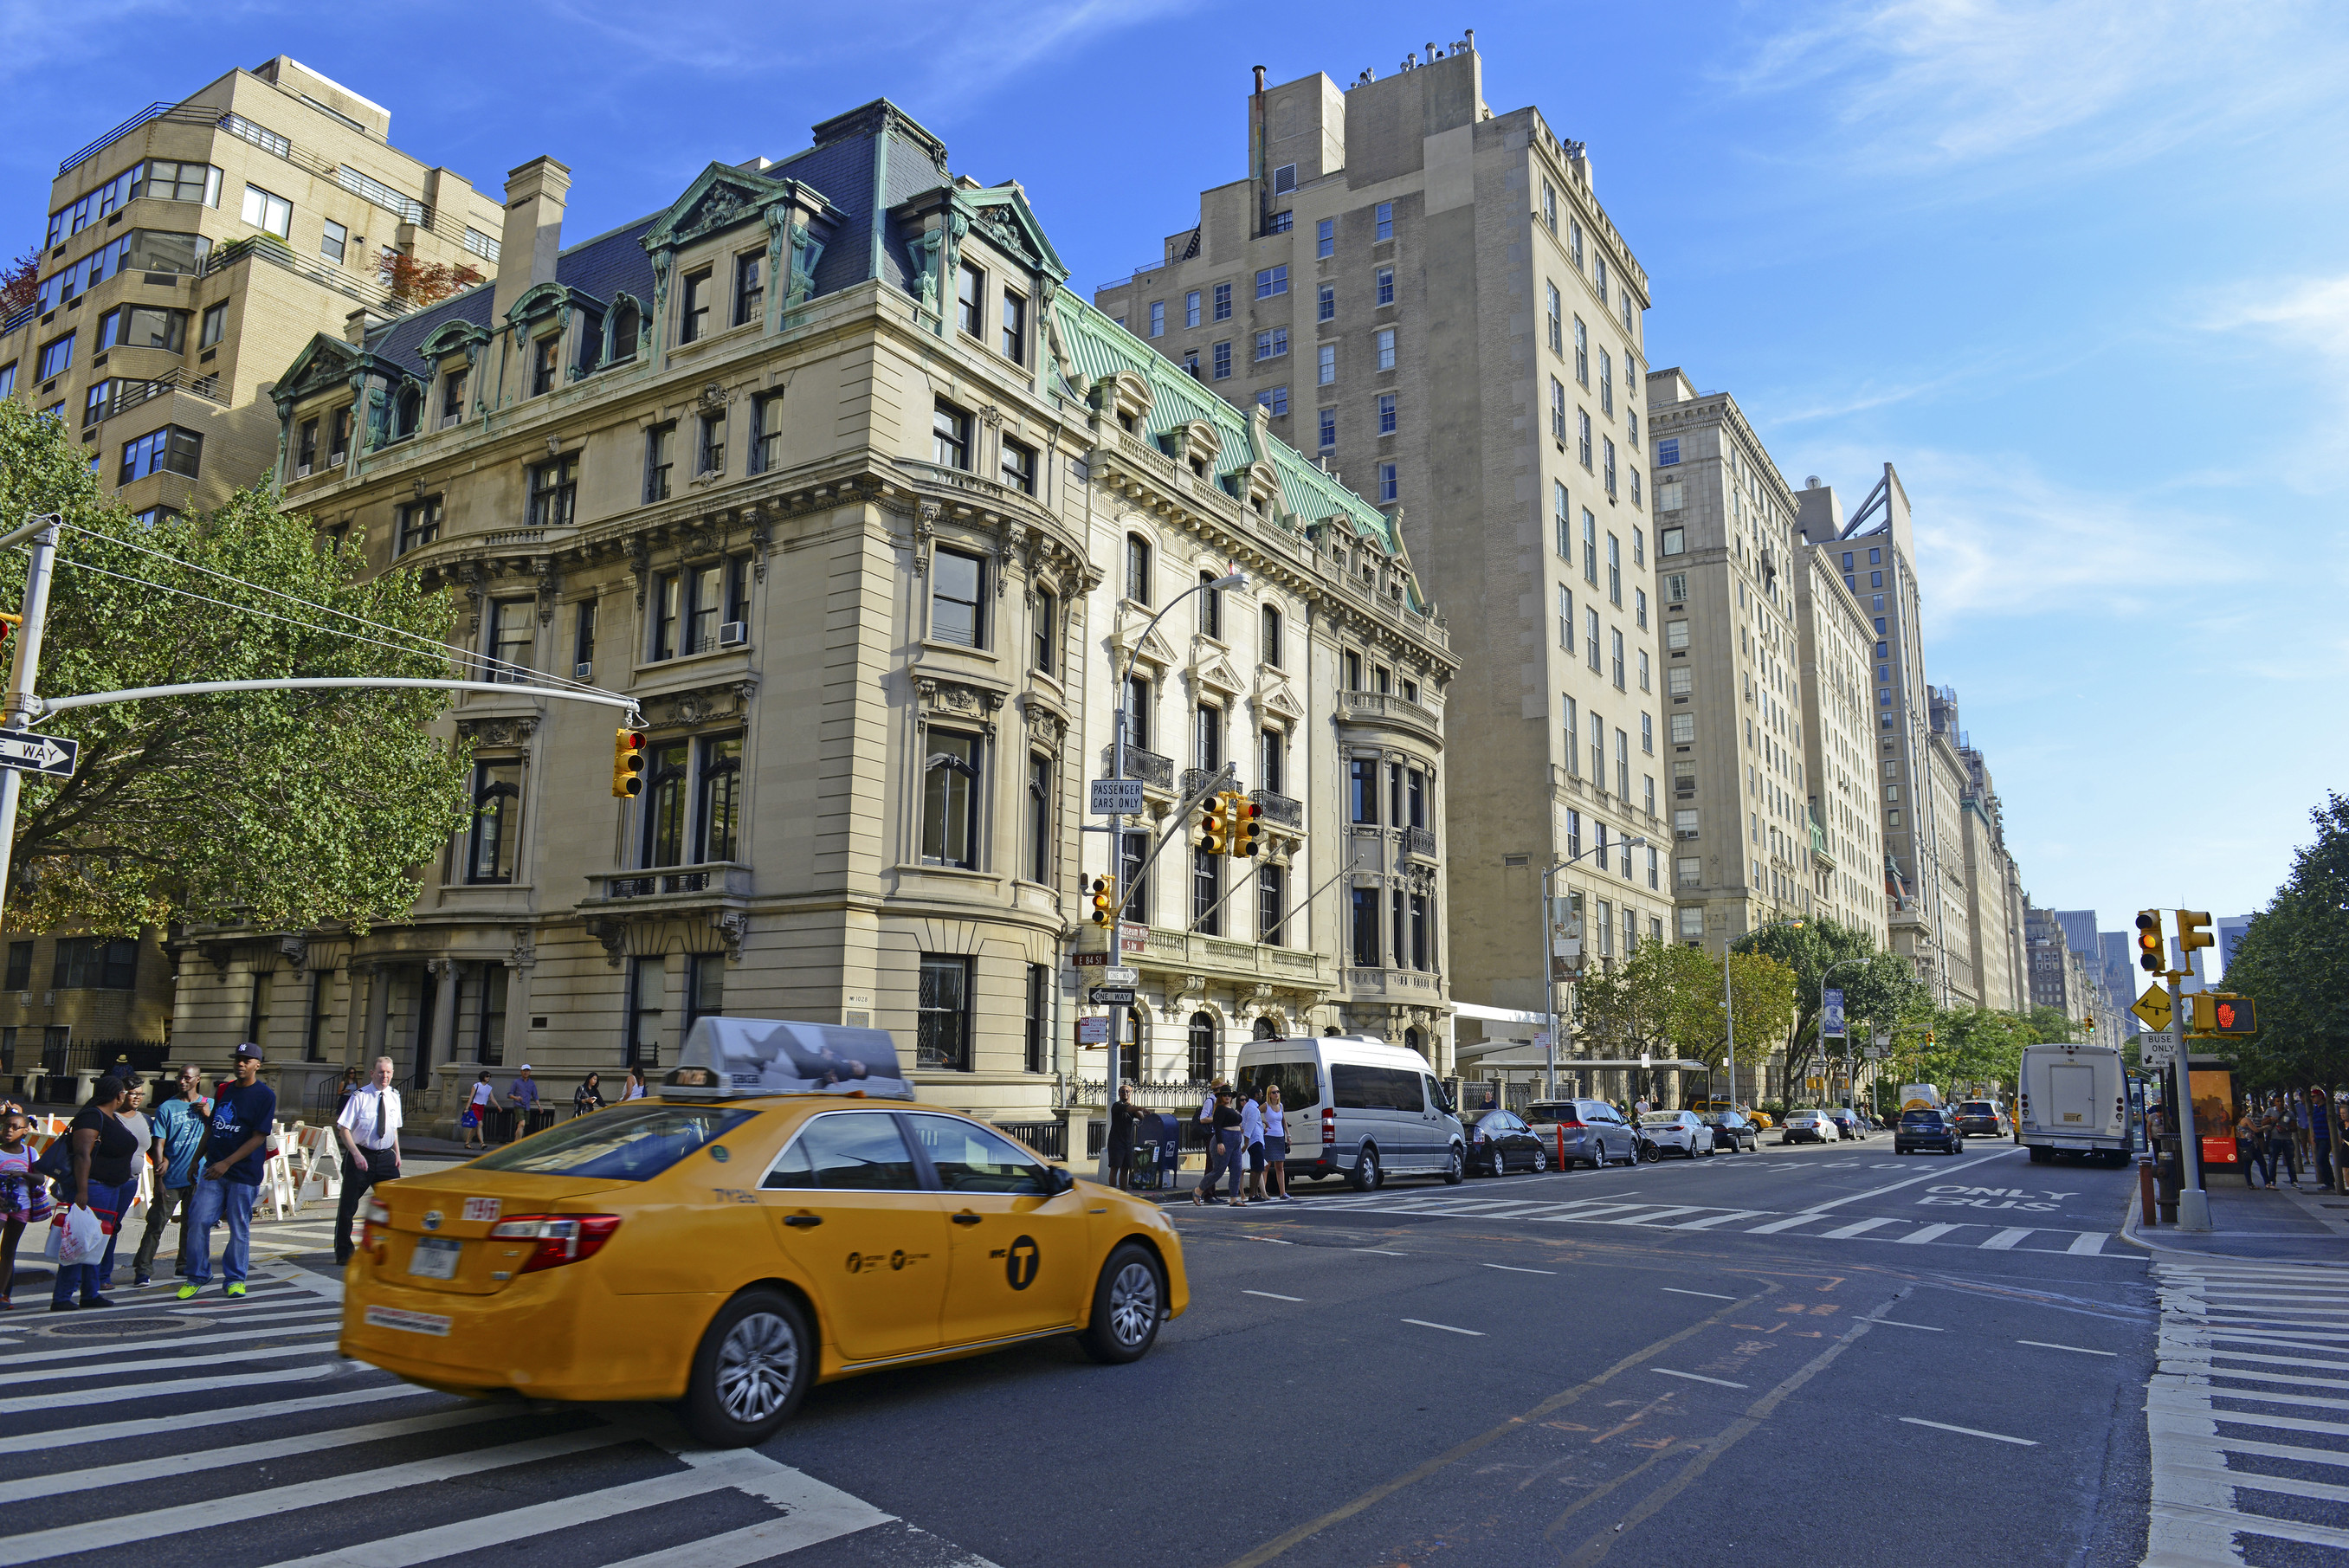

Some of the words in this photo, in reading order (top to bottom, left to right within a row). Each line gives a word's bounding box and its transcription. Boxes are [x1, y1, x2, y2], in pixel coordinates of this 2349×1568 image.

[23, 745, 58, 761] WAY
[1094, 784, 1140, 795] PASSENGER
[1093, 797, 1113, 808] CARS
[1119, 797, 1139, 808] ONLY
[1139, 927, 1149, 938] Mile
[1079, 956, 1082, 965] E
[1085, 956, 1094, 965] 84
[1095, 955, 1102, 965] St
[1925, 1185, 2081, 1200] ONLY
[1914, 1196, 2061, 1211] BUS
